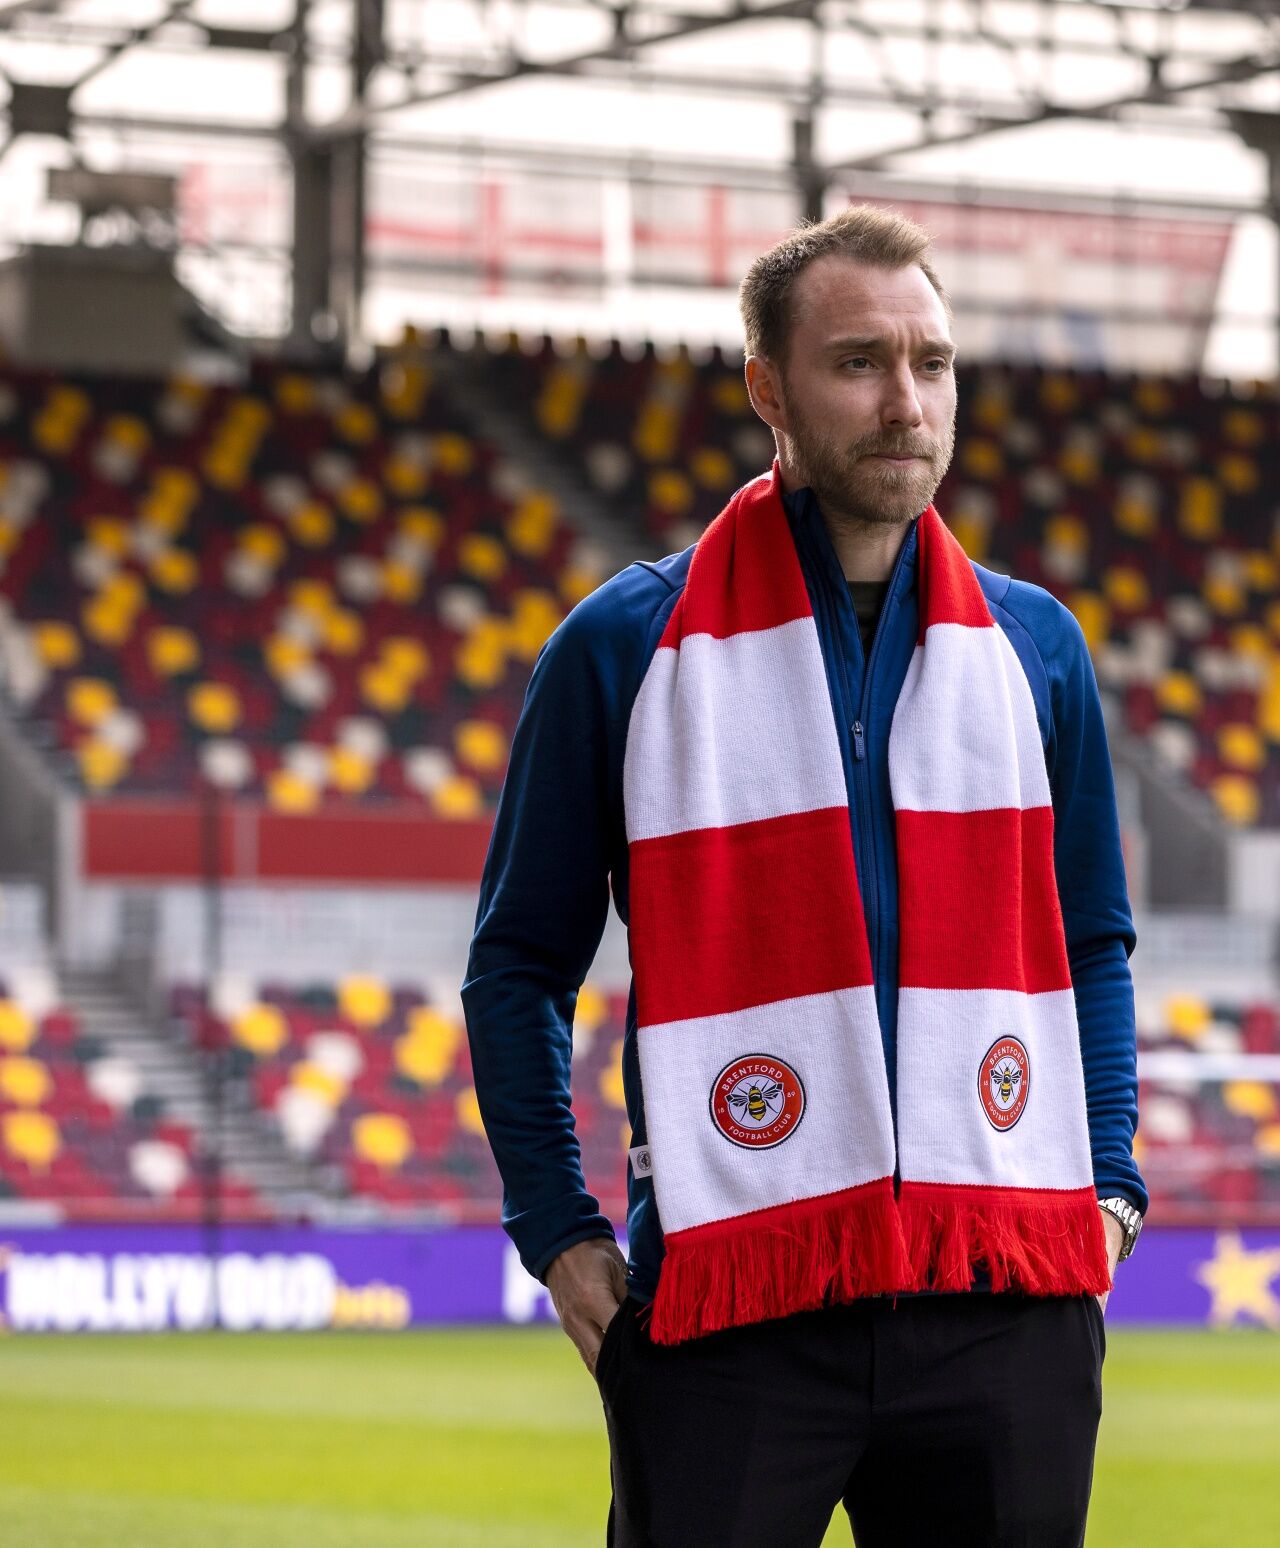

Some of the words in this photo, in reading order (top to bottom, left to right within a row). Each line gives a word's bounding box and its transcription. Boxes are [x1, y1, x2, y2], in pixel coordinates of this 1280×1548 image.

[989, 1045, 1025, 1065] BRENTFORD
[722, 1065, 783, 1091] BRENTFORD
[728, 1125, 773, 1140] FOOTBALL
[773, 1113, 792, 1133] CLUB
